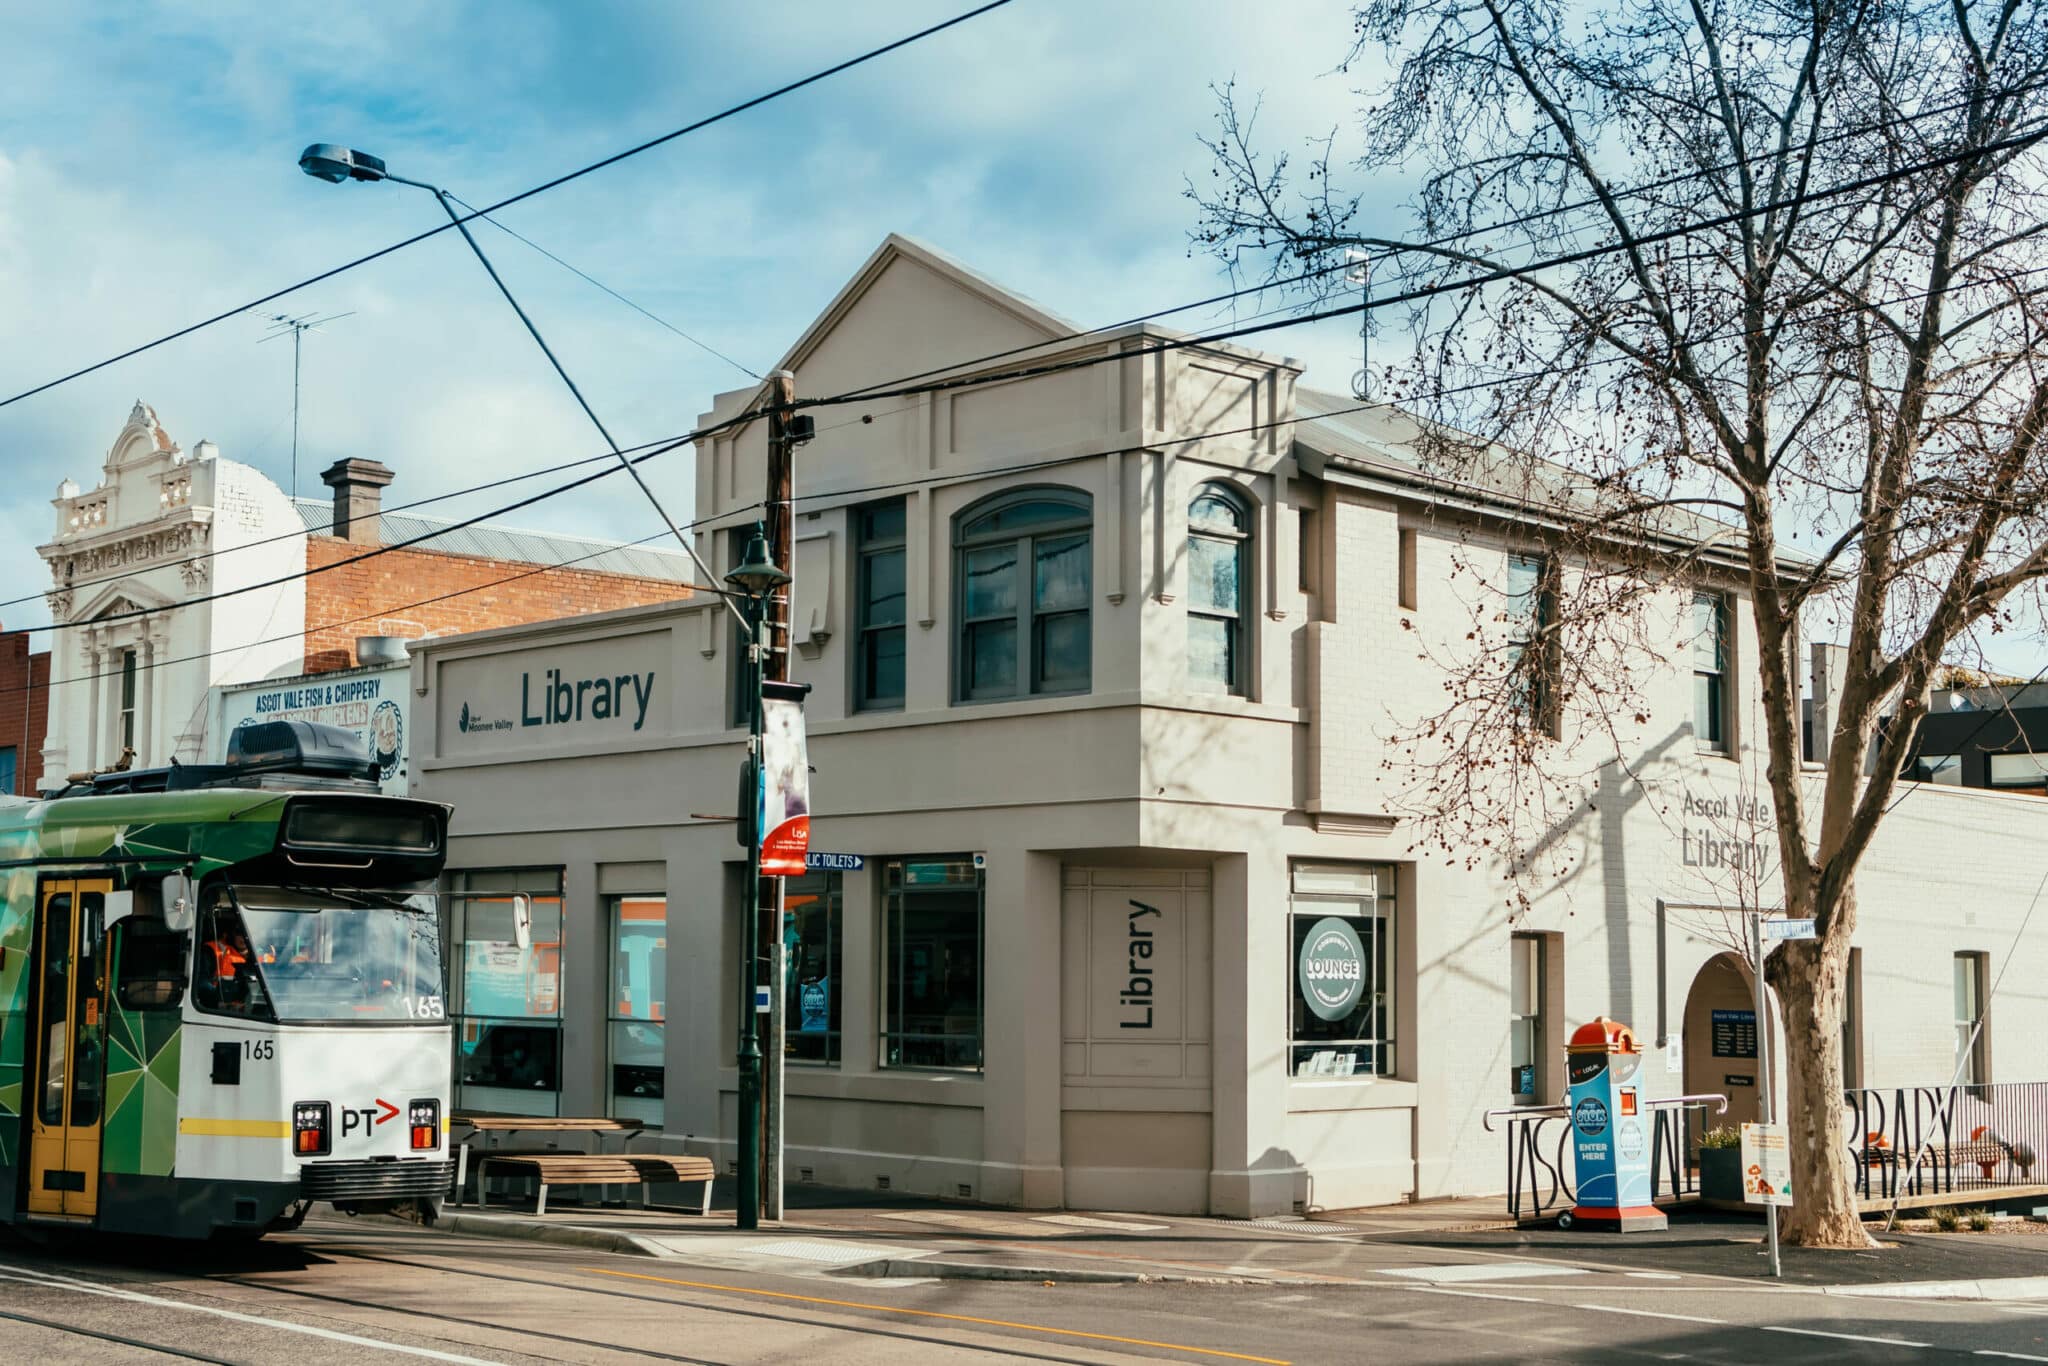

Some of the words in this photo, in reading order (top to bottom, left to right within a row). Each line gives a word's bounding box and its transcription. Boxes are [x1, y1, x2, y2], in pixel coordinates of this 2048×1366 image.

[256, 692, 281, 713] ASCOT
[284, 690, 303, 710] VALE
[305, 687, 323, 708] FISH
[325, 686, 332, 704] &
[334, 679, 381, 703] CHIPPERY
[522, 669, 655, 731] Library
[469, 722, 493, 732] Moonee
[495, 720, 513, 731] Valley
[1683, 790, 1728, 818] Ascot
[1736, 794, 1769, 822] Vale
[805, 854, 820, 867] LIC
[823, 854, 854, 868] TOILETS
[1682, 827, 1769, 880] Library
[1120, 899, 1161, 1028] Library
[1306, 958, 1360, 980] LOUNGE
[403, 996, 443, 1019] 165
[244, 1040, 274, 1061] 165
[1579, 1143, 1607, 1152] ENTER
[1582, 1152, 1605, 1160] HERE
